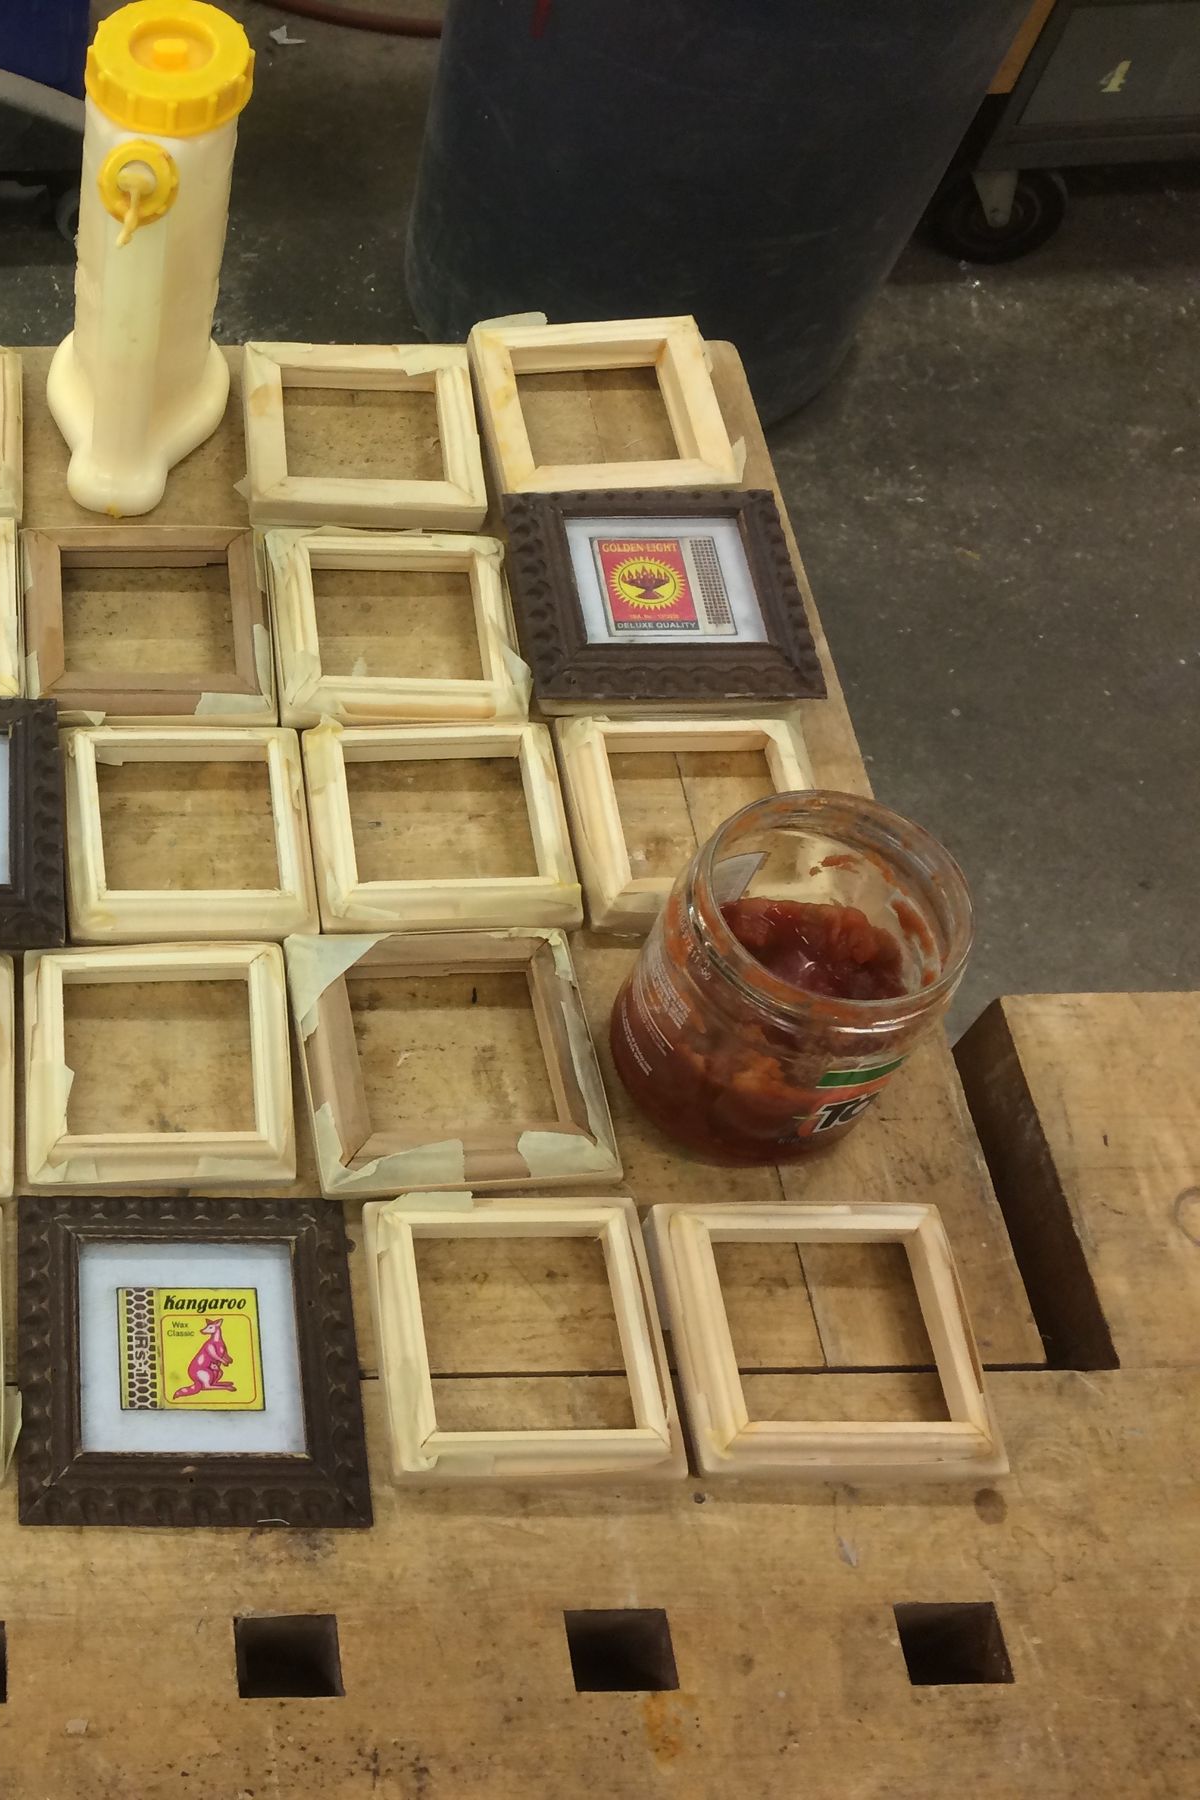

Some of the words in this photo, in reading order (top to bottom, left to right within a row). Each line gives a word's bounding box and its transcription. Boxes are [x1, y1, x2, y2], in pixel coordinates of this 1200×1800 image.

[601, 543, 644, 553] GOLDEN
[645, 543, 678, 552] LIGHT
[163, 1295, 247, 1313] Kangaroo
[171, 1320, 189, 1328] Wax
[166, 1329, 195, 1337] Classic
